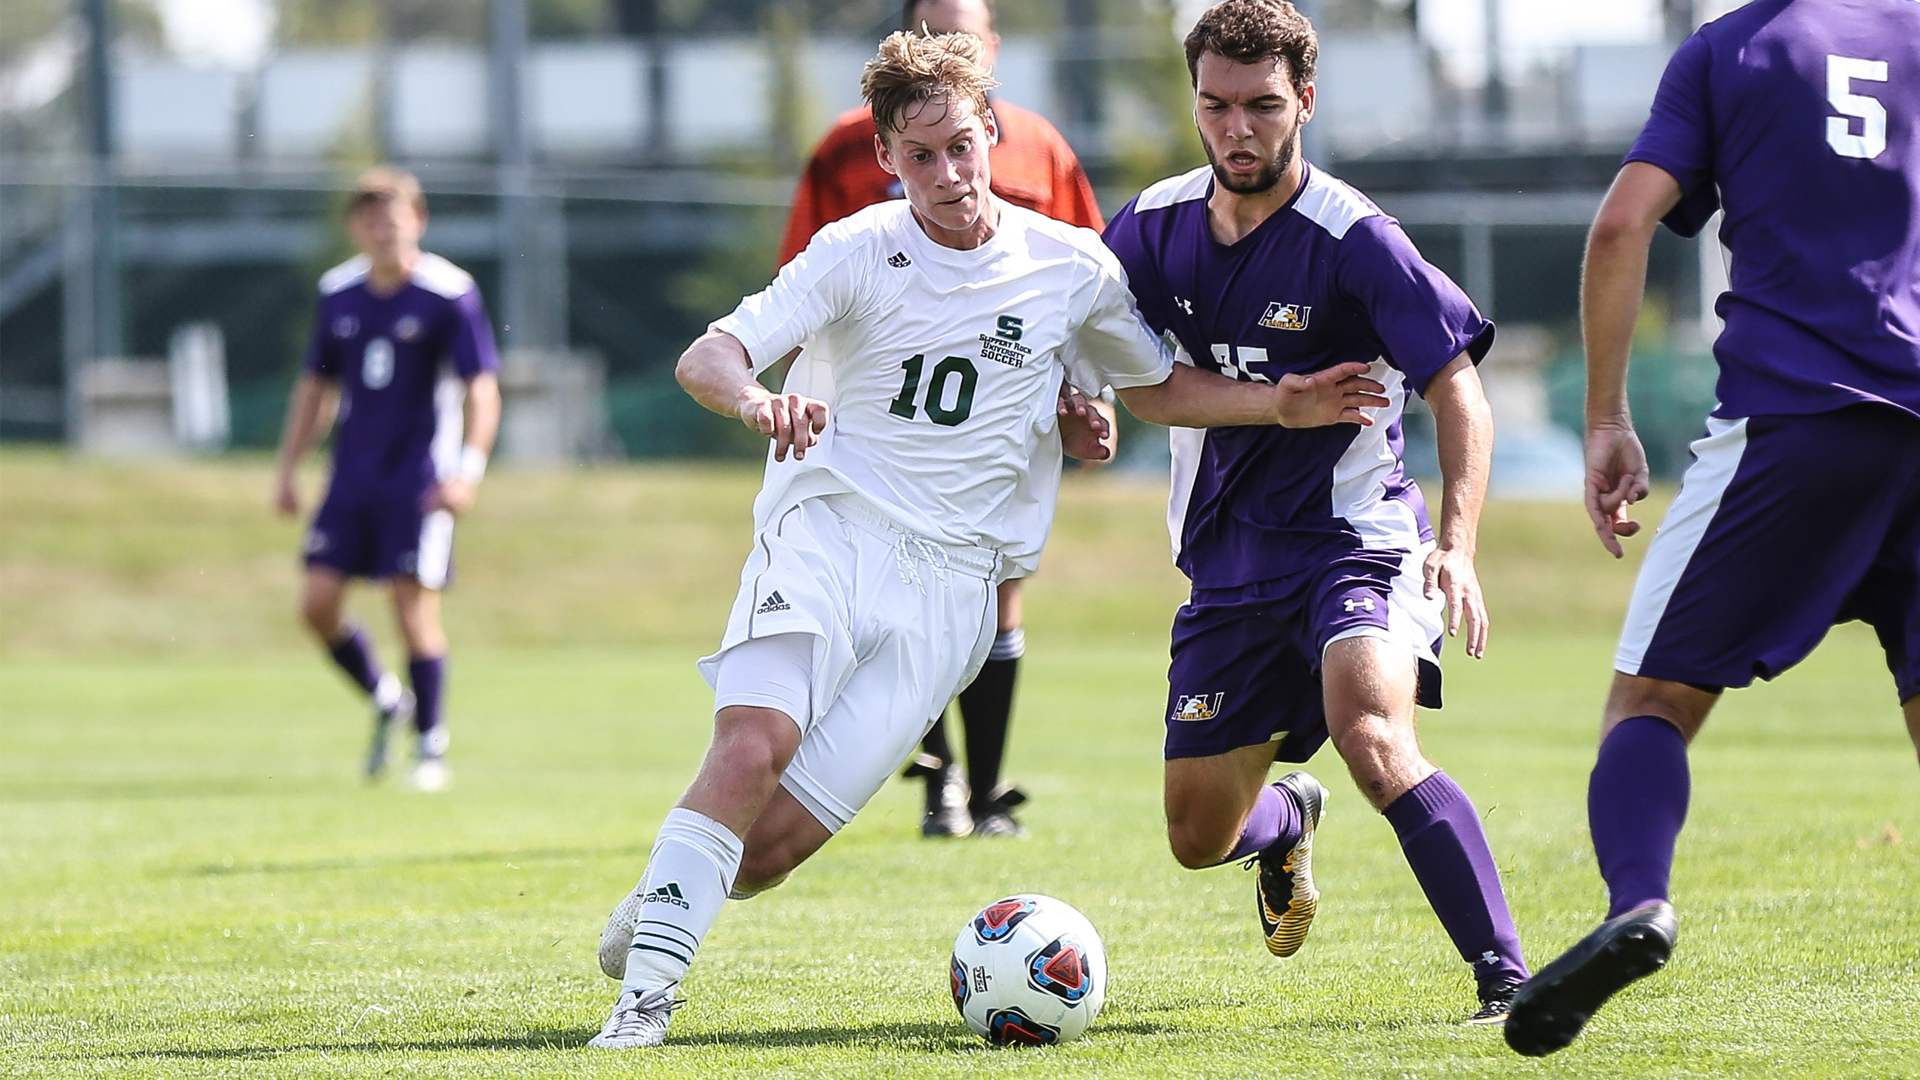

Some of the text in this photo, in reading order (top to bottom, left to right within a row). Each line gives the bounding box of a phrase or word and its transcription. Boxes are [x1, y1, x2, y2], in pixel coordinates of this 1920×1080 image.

[1826, 54, 1888, 159] 5
[996, 315, 1024, 341] S
[980, 349, 1023, 368] SOCCER
[888, 354, 979, 427] 10
[757, 603, 791, 614] adidas
